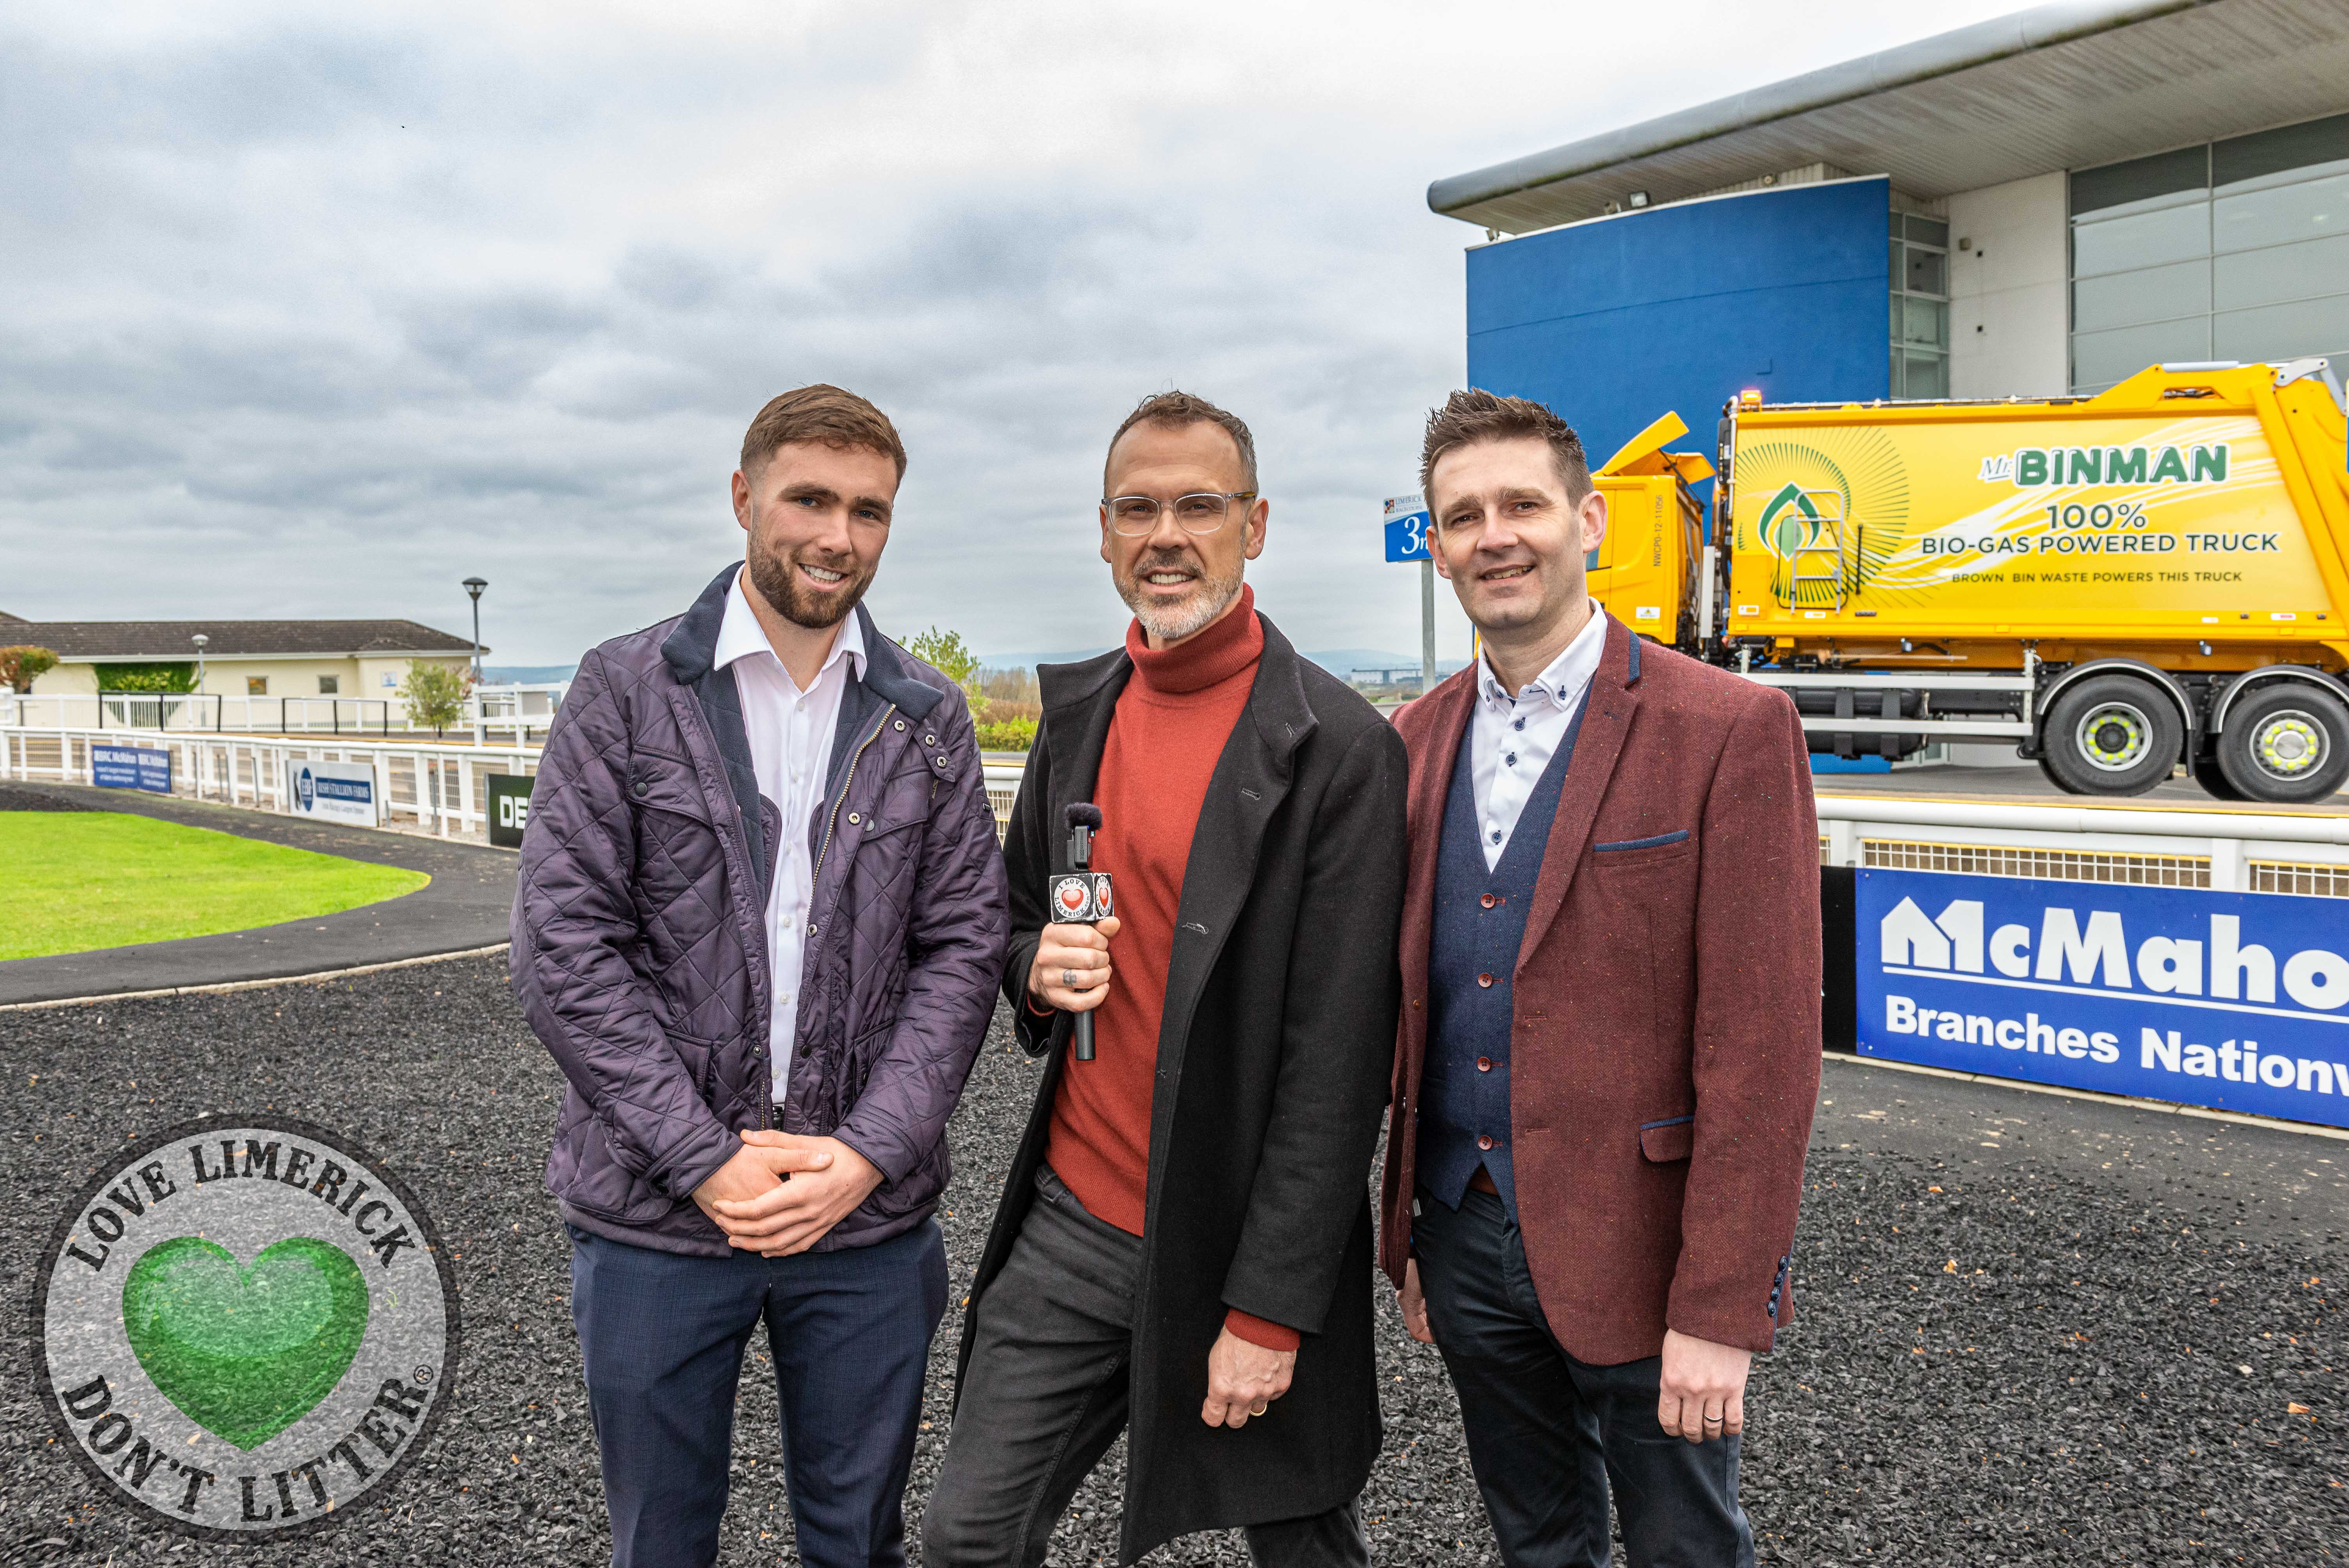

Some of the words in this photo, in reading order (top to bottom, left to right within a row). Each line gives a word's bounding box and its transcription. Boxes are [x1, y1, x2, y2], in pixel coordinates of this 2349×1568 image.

[1980, 457, 2012, 480] Mr.
[2016, 446, 2227, 485] BINMAN
[1395, 496, 1422, 505] LIMERICK
[2047, 502, 2147, 529] 100%
[1401, 516, 1428, 554] 3r
[1922, 537, 2030, 554] BIO-GAS
[2041, 535, 2176, 553] POWERED
[2185, 533, 2279, 551] TRUCK
[1952, 573, 2004, 583] BROWN
[2012, 573, 2035, 583] BIN
[2041, 572, 2087, 582] WASTE
[2093, 572, 2153, 582] POWERS
[2158, 572, 2189, 581] THIS
[2194, 571, 2242, 581] TRUCK
[499, 795, 530, 829] DE
[1064, 878, 1085, 889] LOVE
[1886, 994, 2120, 1063] Branches
